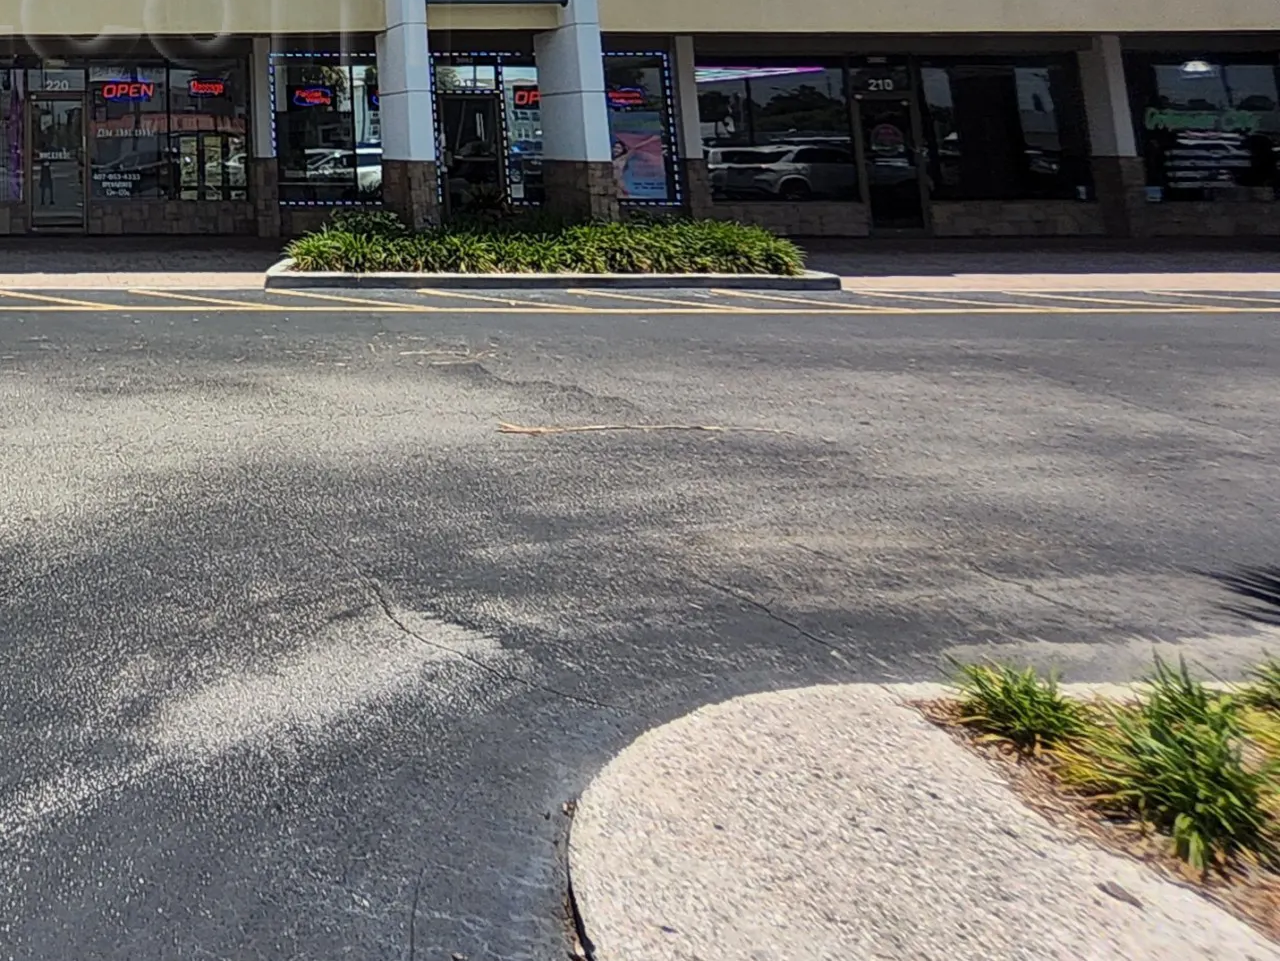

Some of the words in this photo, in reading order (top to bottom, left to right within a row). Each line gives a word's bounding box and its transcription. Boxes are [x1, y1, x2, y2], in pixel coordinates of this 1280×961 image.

[45, 79, 69, 91] 220
[102, 82, 155, 99] OPEN
[867, 78, 894, 91] 210
